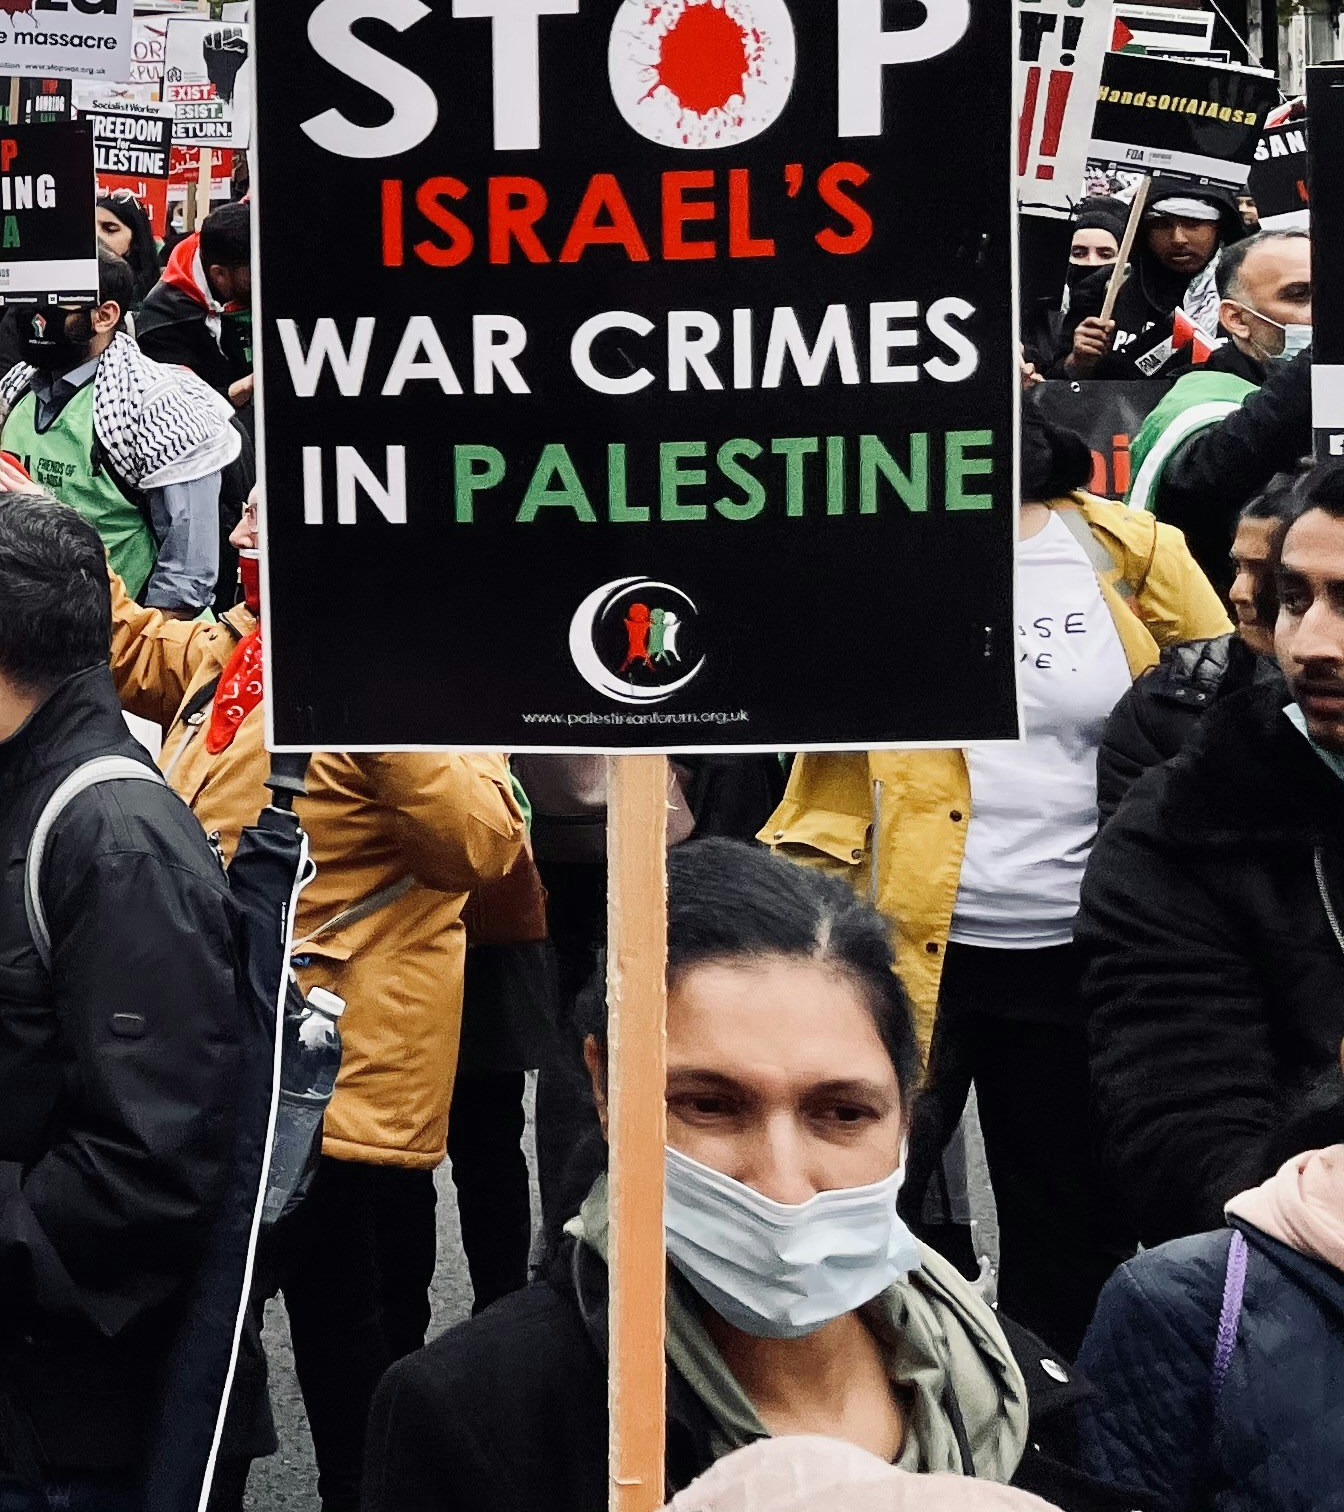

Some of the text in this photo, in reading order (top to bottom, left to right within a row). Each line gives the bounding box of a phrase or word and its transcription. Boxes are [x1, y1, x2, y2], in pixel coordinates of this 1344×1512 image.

[14, 31, 118, 50] massacre
[92, 99, 160, 115] Socialist Worker
[176, 103, 223, 120] ESIST.
[1096, 85, 1258, 126] HandsOffAlAqsa
[116, 138, 131, 150] for
[1253, 130, 1310, 161] SAN
[275, 296, 980, 398] WAR CRIMES
[302, 444, 407, 526] IN
[454, 429, 994, 524] PALESTINE
